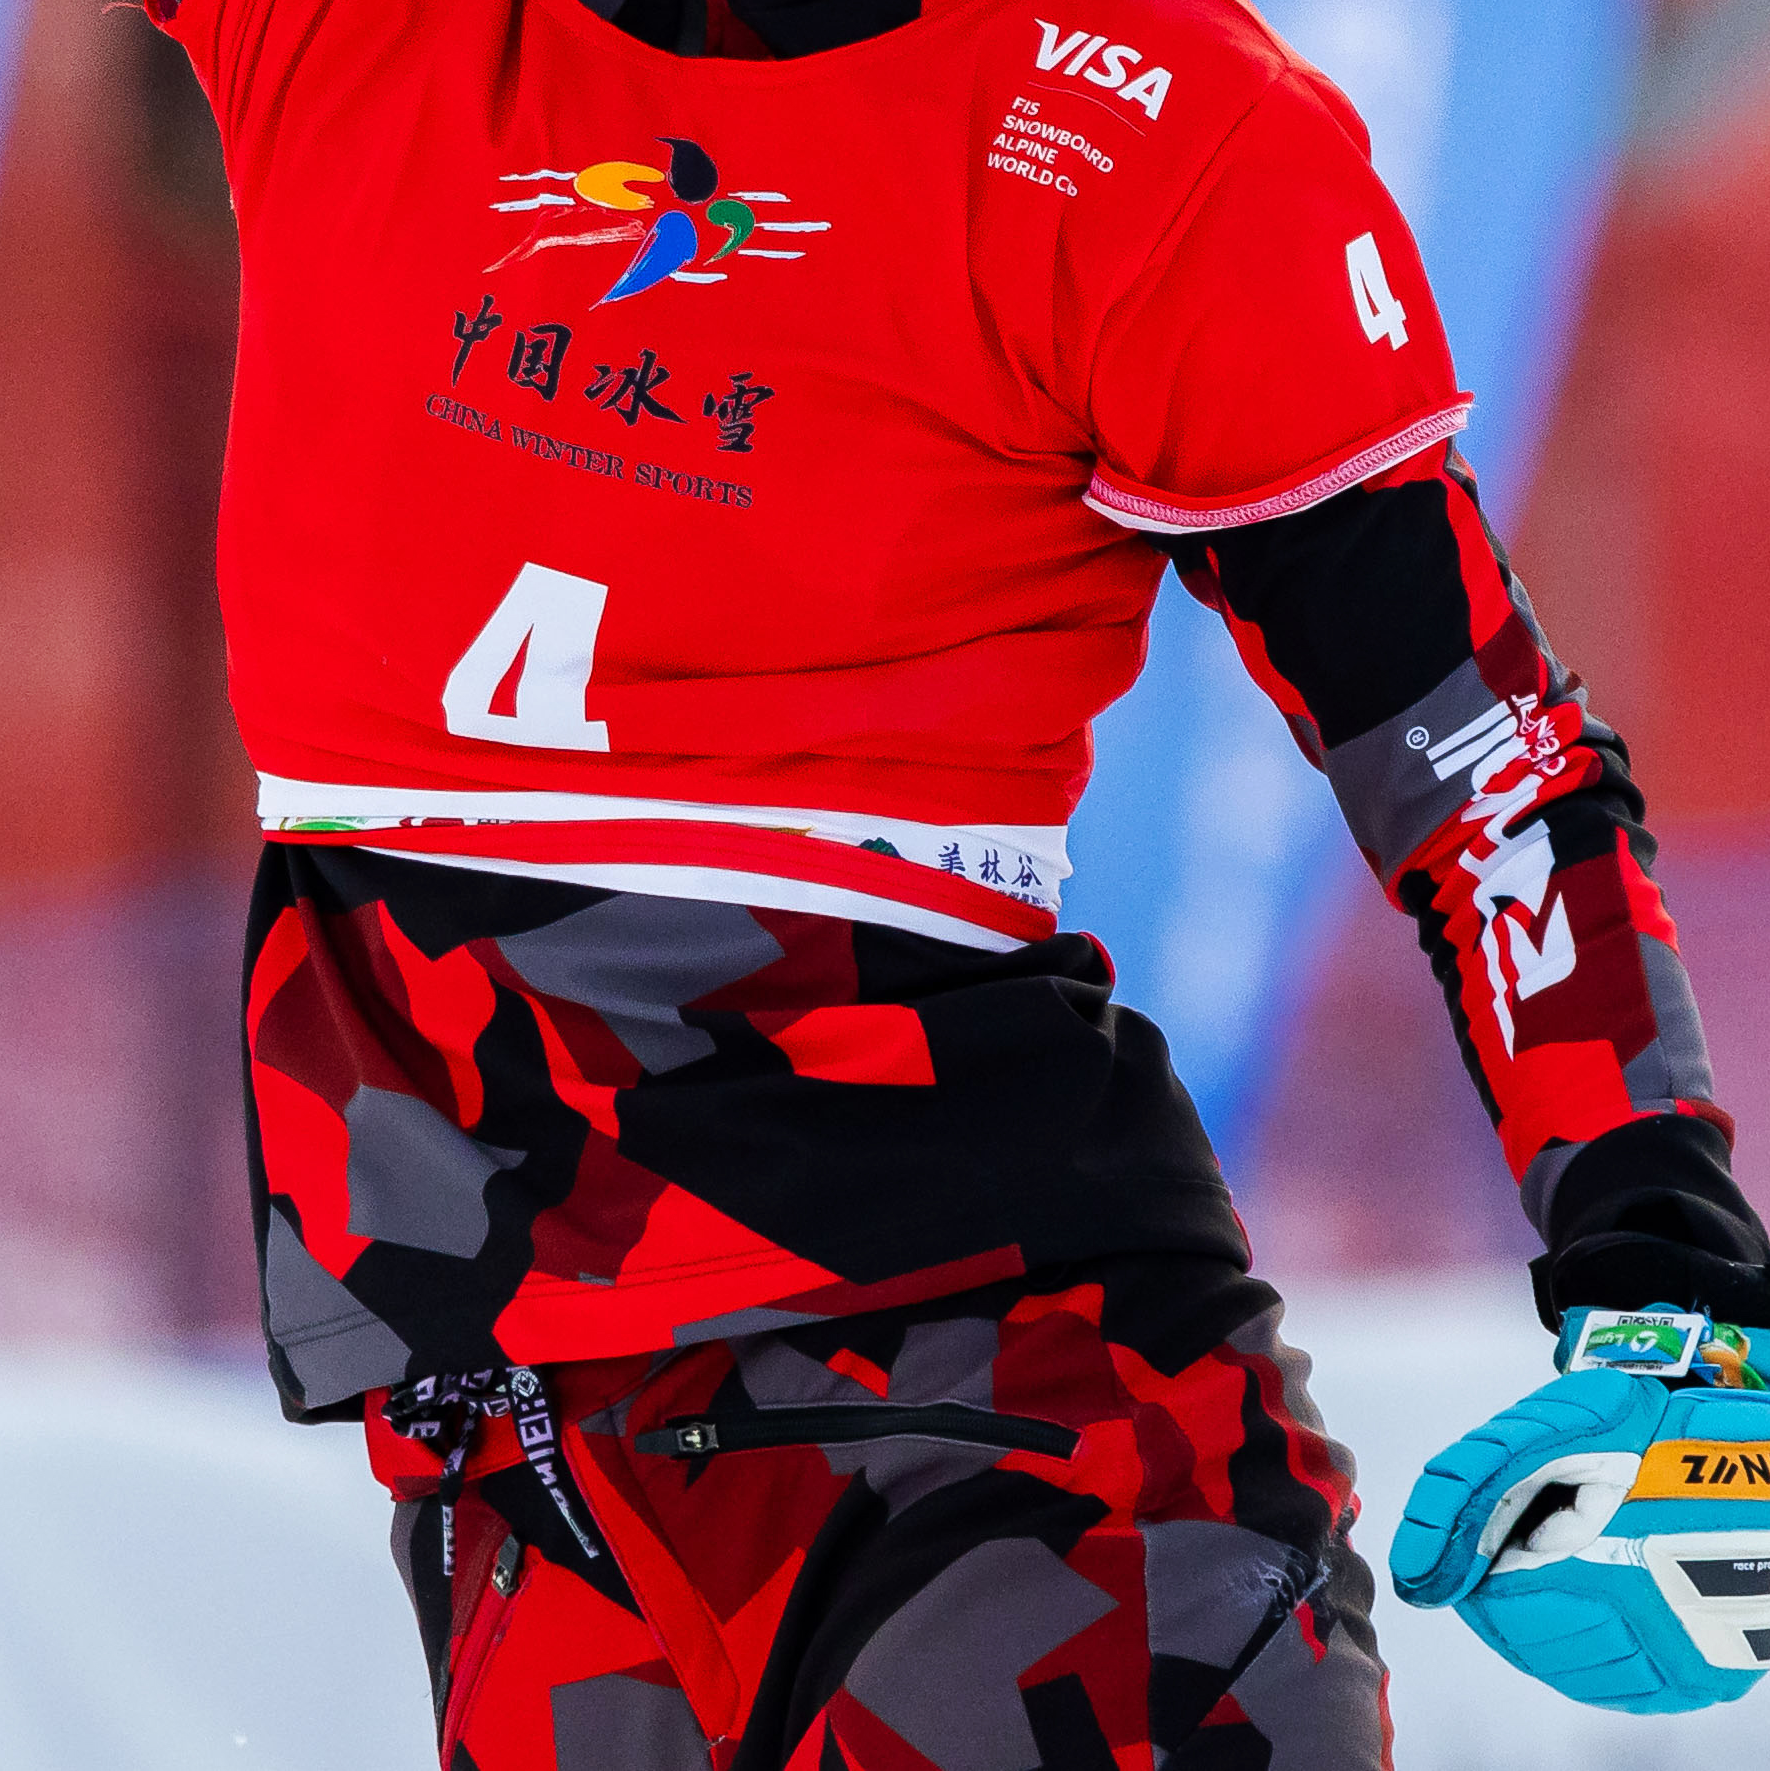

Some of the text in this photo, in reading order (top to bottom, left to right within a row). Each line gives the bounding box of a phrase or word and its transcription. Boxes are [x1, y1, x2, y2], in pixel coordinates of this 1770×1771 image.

[1033, 17, 1173, 121] VISA
[1012, 95, 1041, 116] FIS
[987, 151, 1054, 186] WORLD
[992, 132, 1059, 165] ALPINE
[1002, 114, 1114, 173] SNOWBOARD
[1345, 231, 1409, 351] 4
[451, 293, 776, 454] 中国冰雪
[425, 392, 754, 509] CHINA WINTER SPORTS
[441, 561, 611, 753] 4
[937, 842, 1043, 889] 美林谷
[1732, 1562, 1756, 1571] race
